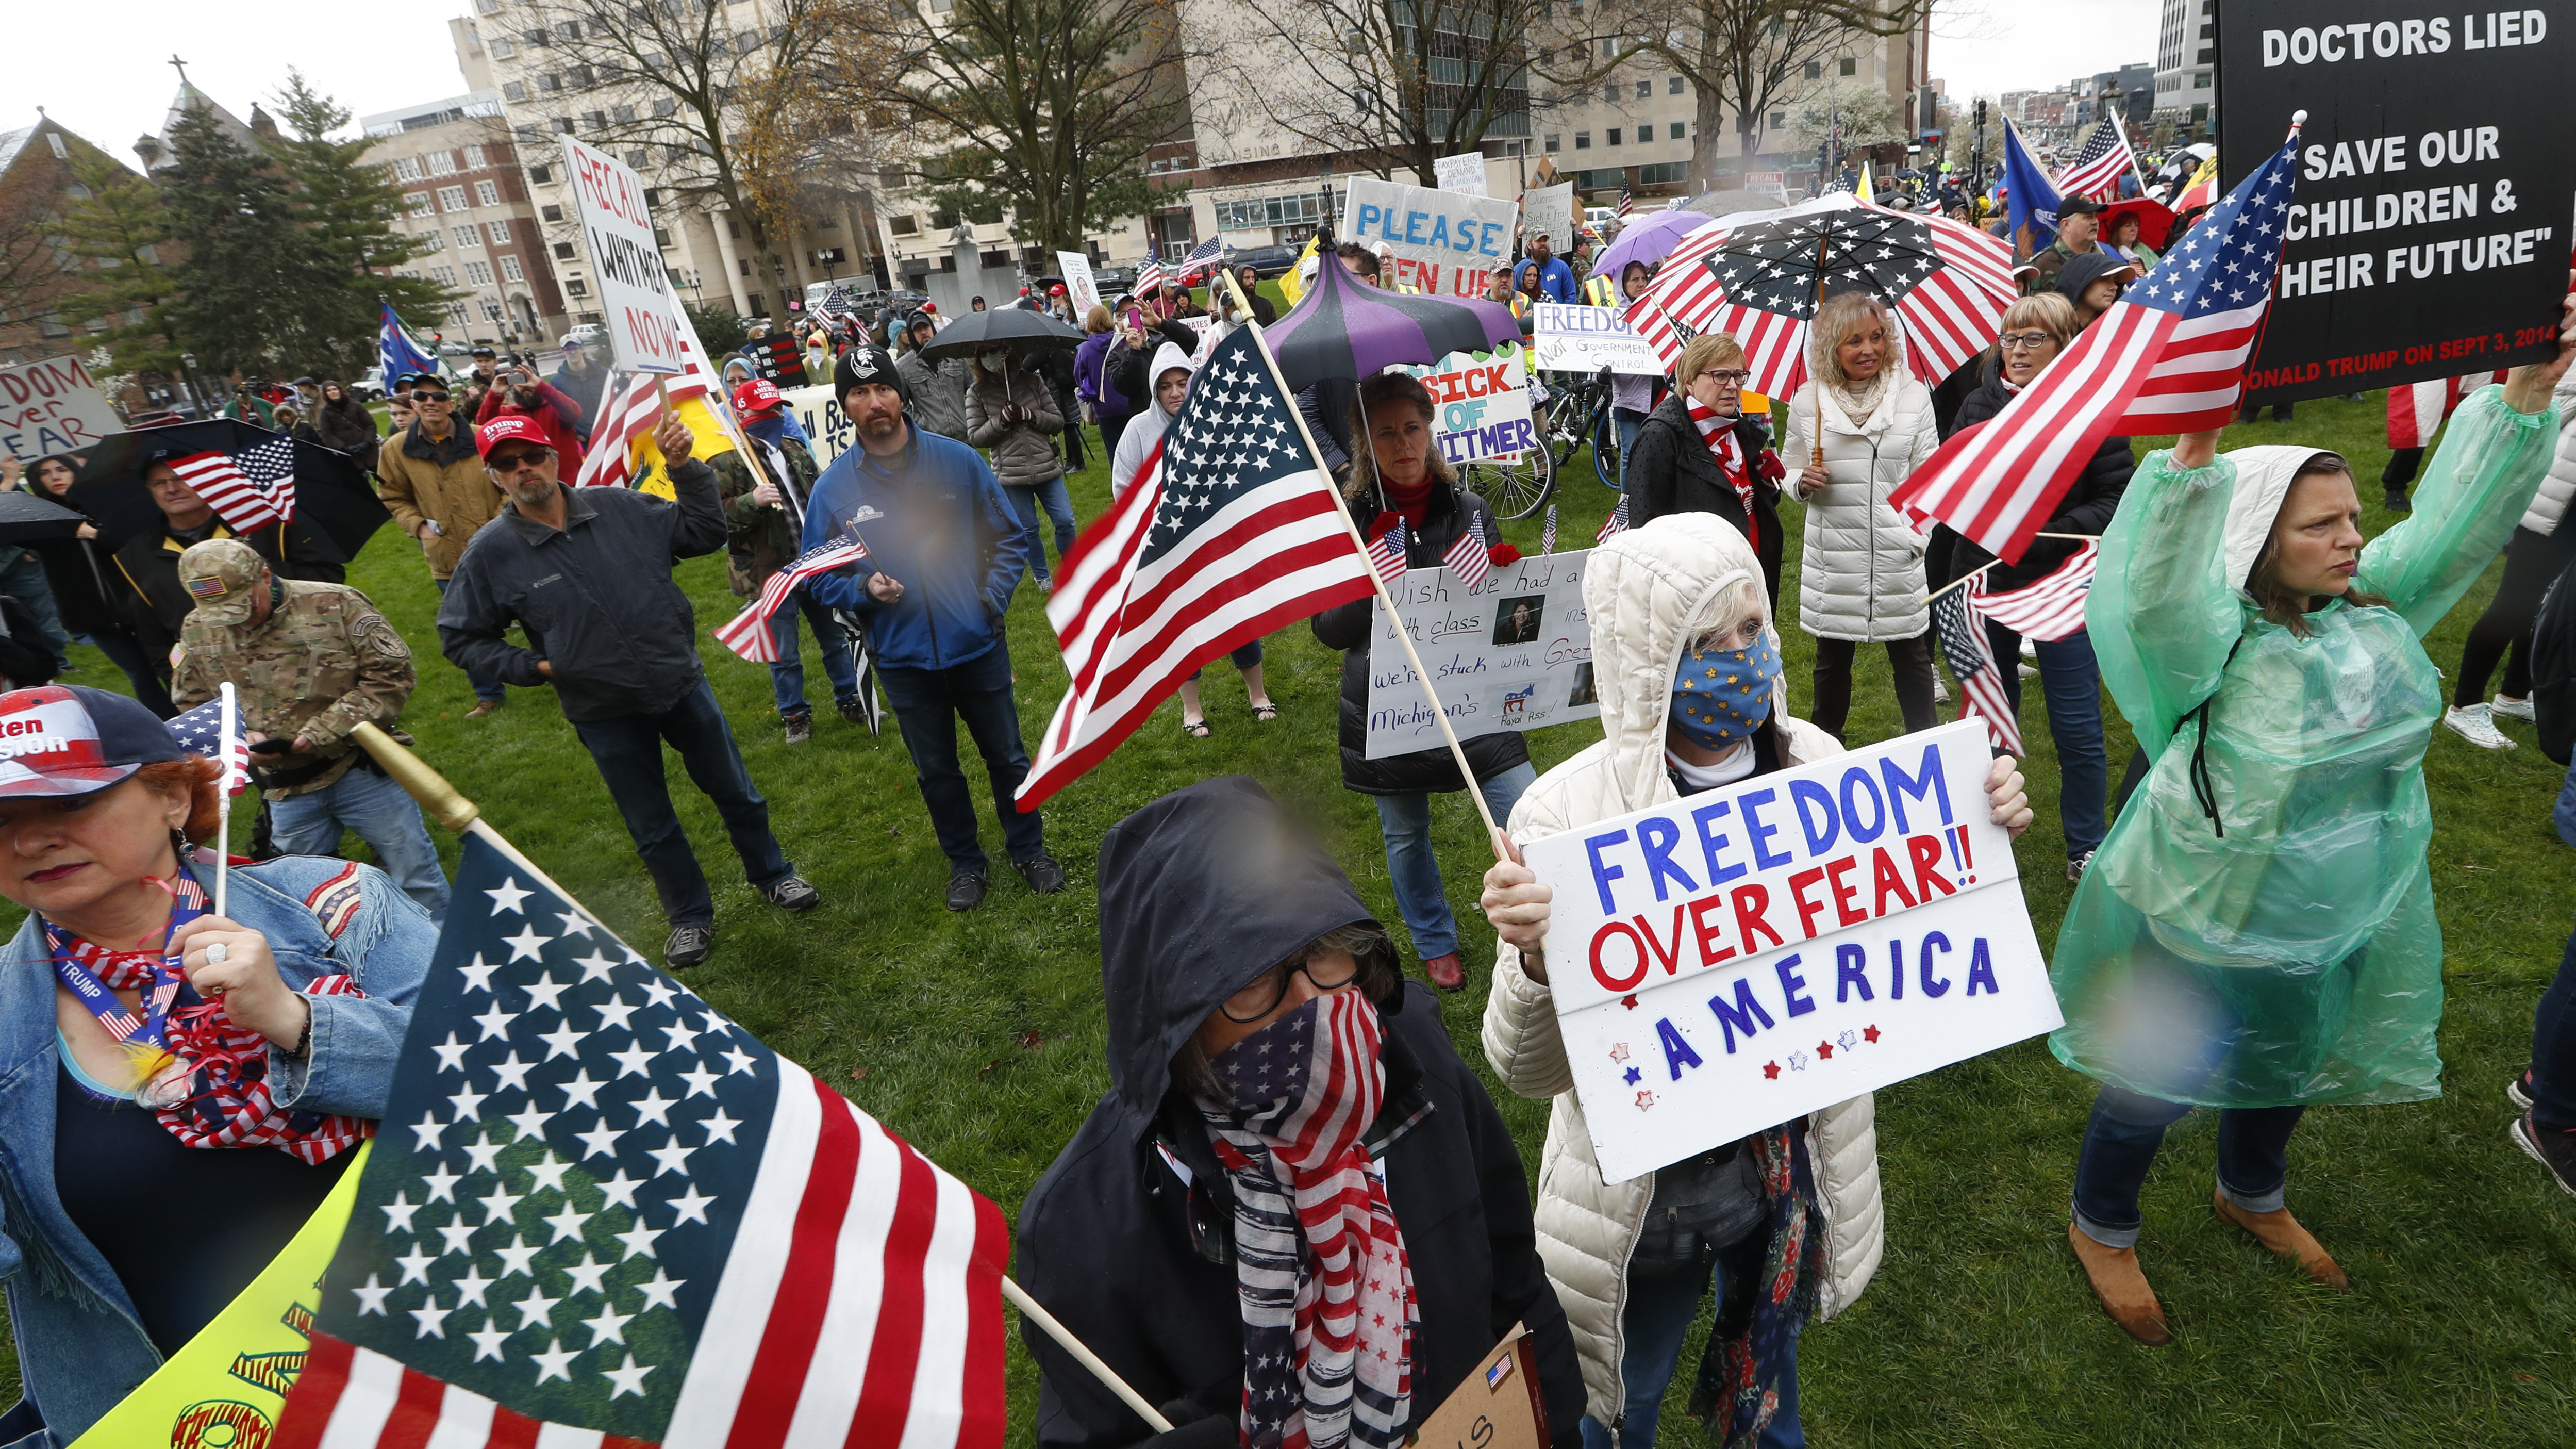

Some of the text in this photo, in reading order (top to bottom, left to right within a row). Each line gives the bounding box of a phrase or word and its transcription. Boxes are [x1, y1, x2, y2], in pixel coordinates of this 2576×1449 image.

[2262, 9, 2547, 67] DOCTORS LIED
[1436, 155, 1477, 170] TAXPAYERS
[2303, 125, 2500, 181] SAVE OUR
[573, 145, 649, 230] RECALL
[1440, 175, 1483, 188] OPEN MICHIGAN
[1448, 166, 1475, 178] DEMAND
[1747, 184, 1781, 192] WHITMER
[1750, 174, 1779, 182] RECALL
[1526, 211, 1544, 222] Sick
[1554, 207, 1568, 219] Frail
[1527, 191, 1569, 205] Quarantine
[2286, 178, 2518, 242] CHILDREN &
[1357, 203, 1503, 256] PLEASE
[1551, 237, 1571, 253] IL!
[1557, 227, 1571, 238] YOUR
[591, 226, 669, 301] WHITMER
[1396, 257, 1440, 294] EN
[2274, 227, 2552, 299] HEIR FUTURE"
[838, 284, 862, 297] FedEx
[624, 306, 684, 372] NOW!
[1539, 337, 1652, 368] NOT GOVERNMENT
[766, 369, 777, 378] CDC
[1591, 353, 1650, 369] CONTROL
[2240, 324, 2556, 392] DONALD TRUMP ON SEPT 3, 2014
[737, 397, 746, 409] 45
[483, 420, 524, 436] Trump
[1437, 418, 1538, 463] ITMER
[1378, 560, 1577, 611] Wish we had a
[1431, 610, 1480, 635] class
[1437, 653, 1487, 680] stuck
[1501, 653, 1532, 669] with
[1544, 637, 1593, 664] Gret
[1372, 693, 1480, 736] Michigan's
[1501, 714, 1523, 727] Royal
[1584, 743, 1954, 916] FREEDOM
[1588, 824, 1977, 992] OVER FEAR!!
[60, 960, 102, 998] TRUMP
[1655, 930, 1999, 1081] AMERICA
